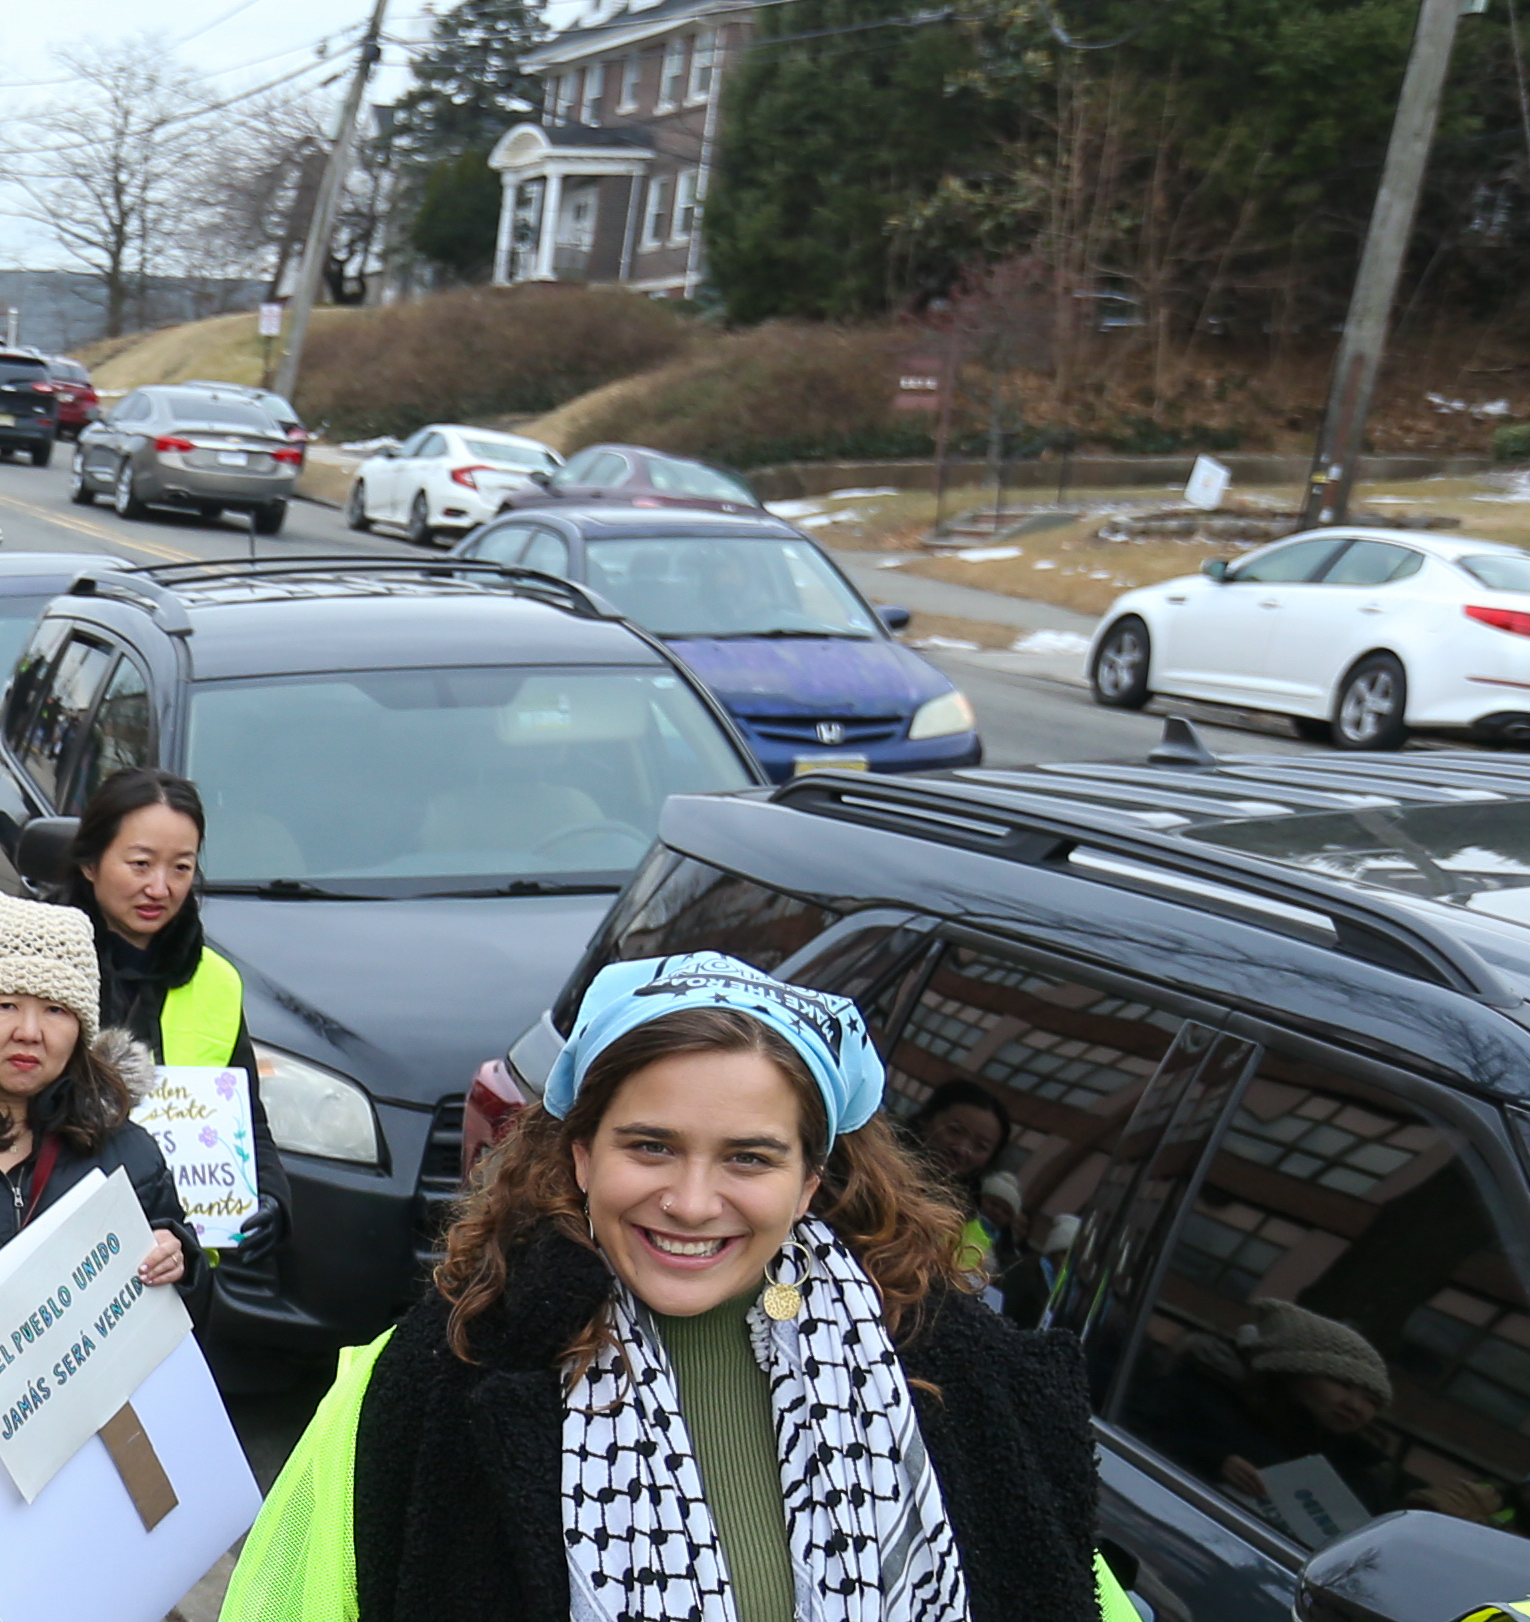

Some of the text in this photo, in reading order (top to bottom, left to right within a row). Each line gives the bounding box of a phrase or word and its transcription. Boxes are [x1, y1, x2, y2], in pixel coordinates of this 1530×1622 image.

[731, 981, 782, 1004] THE
[782, 992, 835, 1043] MAKE
[171, 1162, 236, 1187] ANKS
[182, 1190, 253, 1217] rants
[10, 1285, 72, 1354] PUEBLO
[71, 1232, 120, 1291] UNIDO
[1, 1274, 145, 1440] JAMÁS SERÁ VENCID
